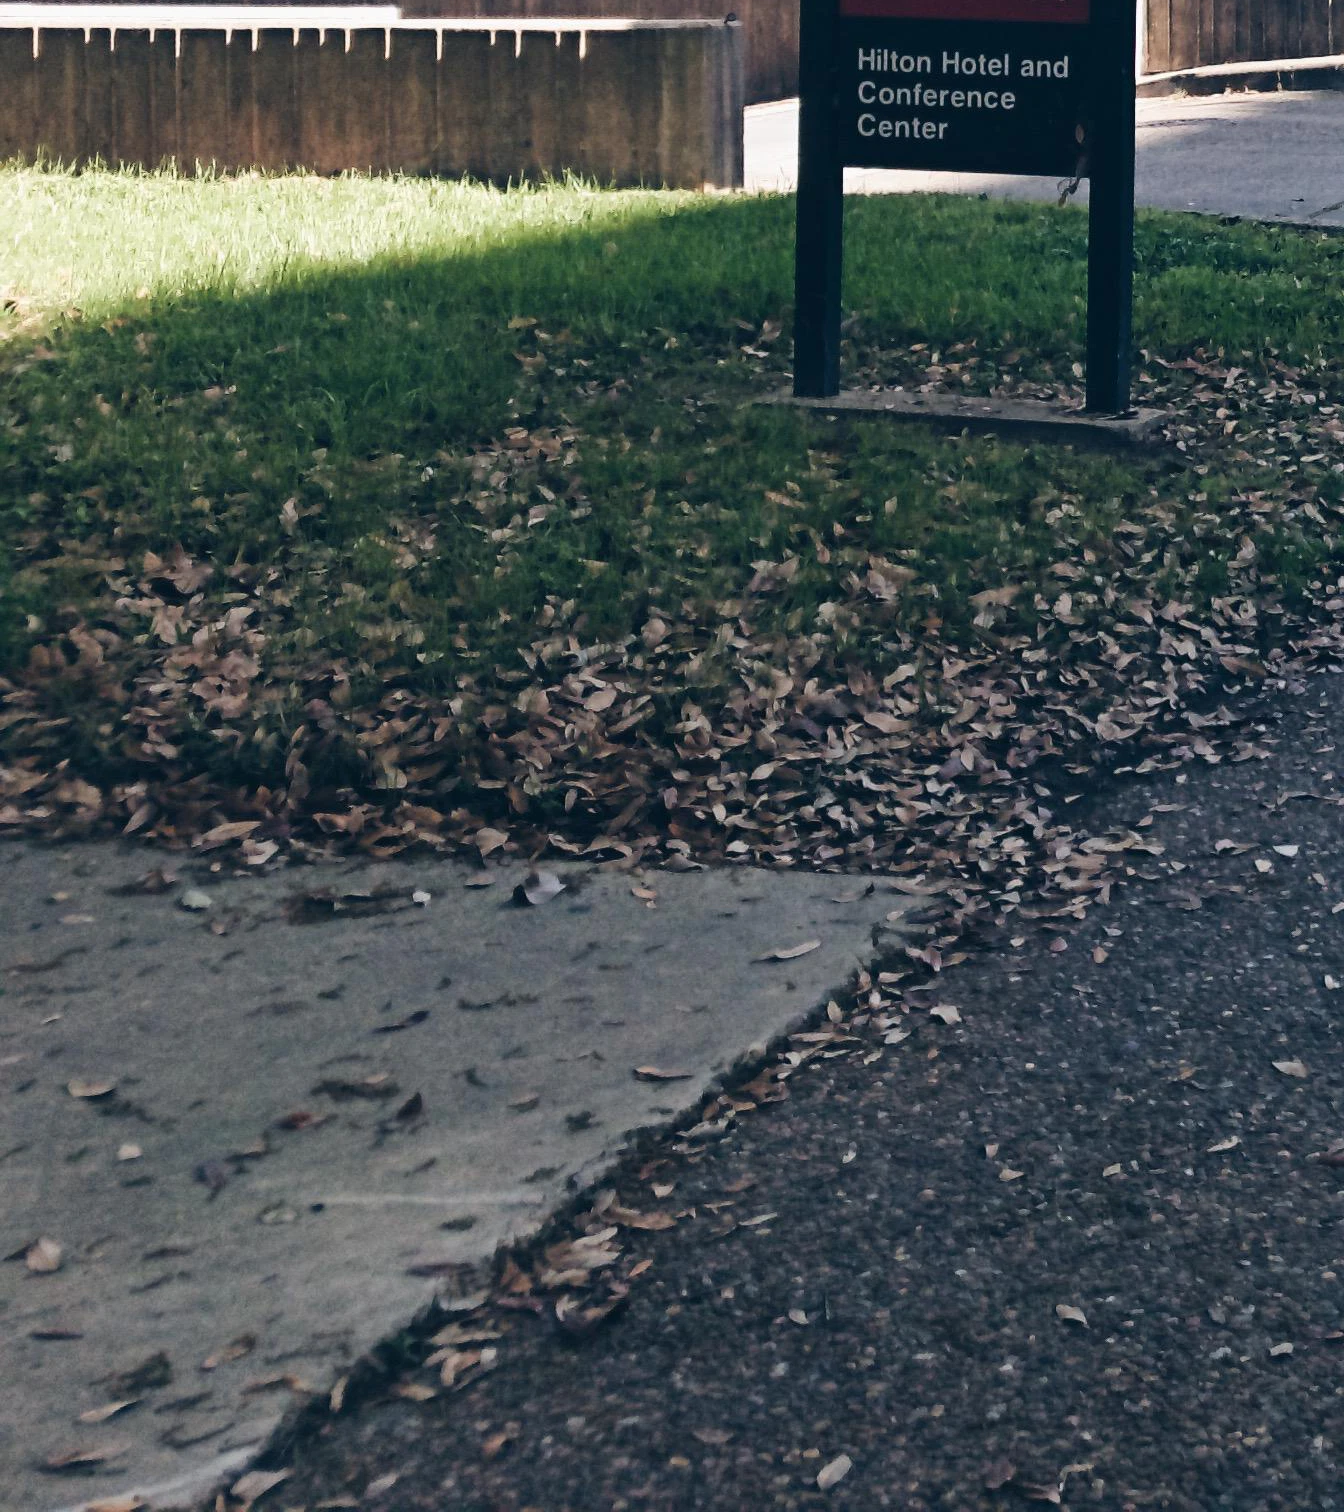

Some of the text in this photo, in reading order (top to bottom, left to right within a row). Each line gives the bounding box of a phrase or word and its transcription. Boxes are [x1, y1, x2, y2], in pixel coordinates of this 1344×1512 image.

[858, 48, 1069, 78] Hilton Hotel and
[858, 81, 1016, 110] Conference
[857, 113, 948, 140] Center
